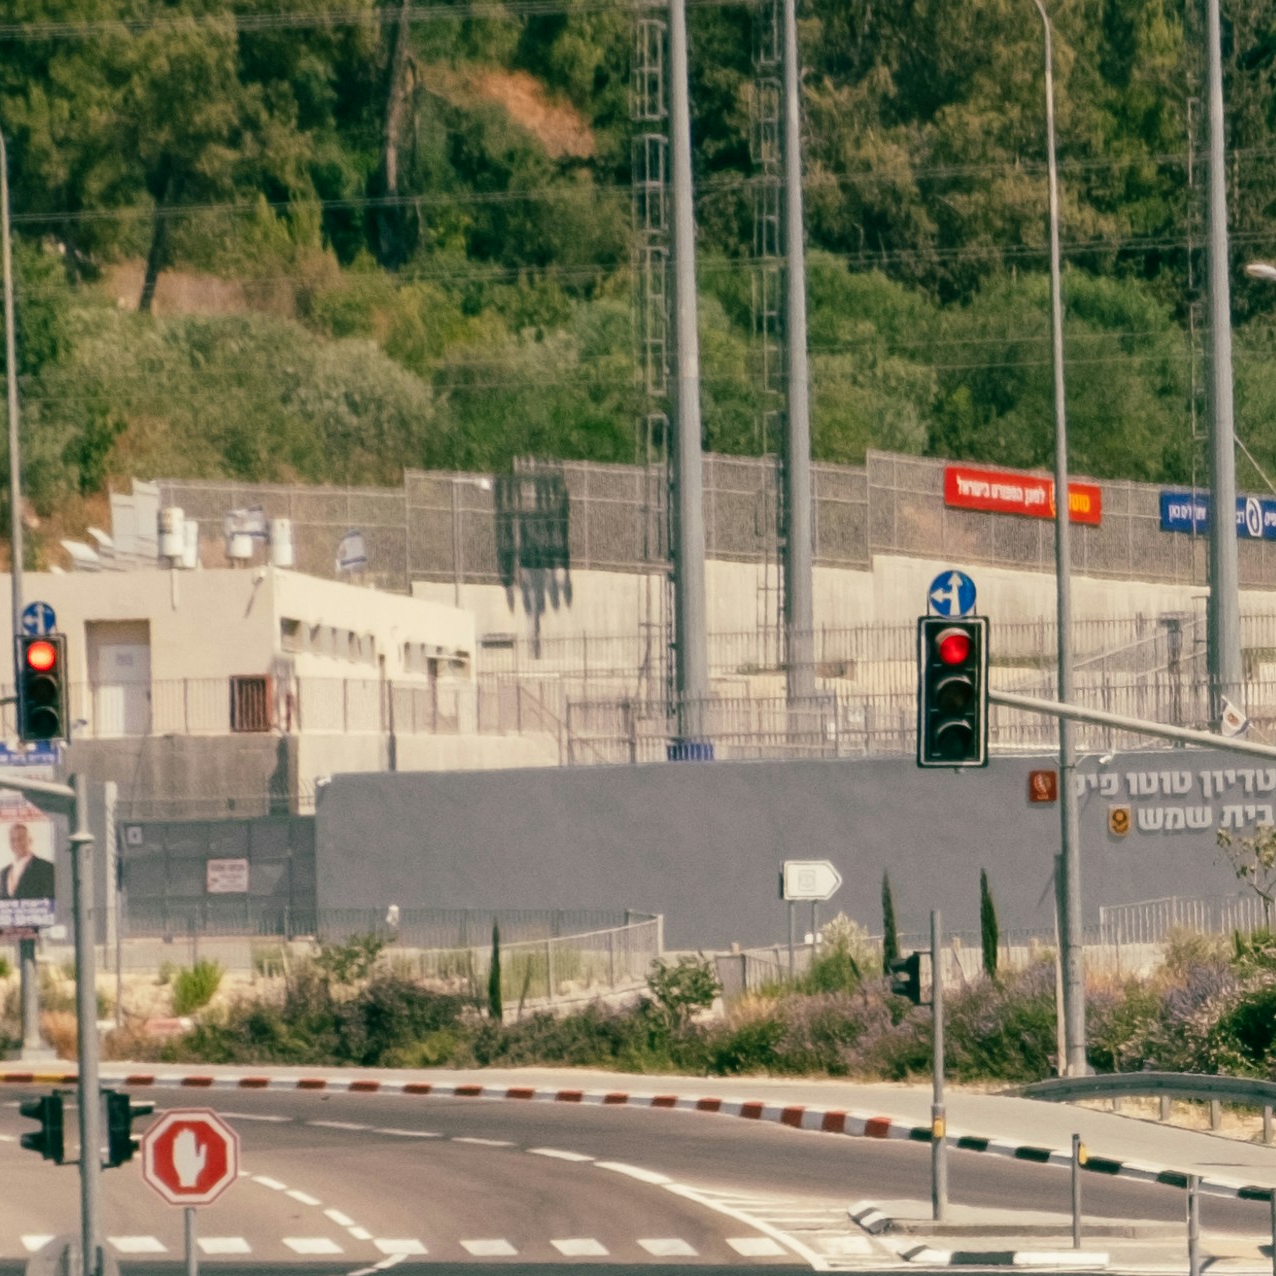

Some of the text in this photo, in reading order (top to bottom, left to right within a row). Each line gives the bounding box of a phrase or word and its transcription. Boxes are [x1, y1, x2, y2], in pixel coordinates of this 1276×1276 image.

[1126, 772, 1193, 796] טוטו
[1137, 804, 1274, 830] בית שמש
